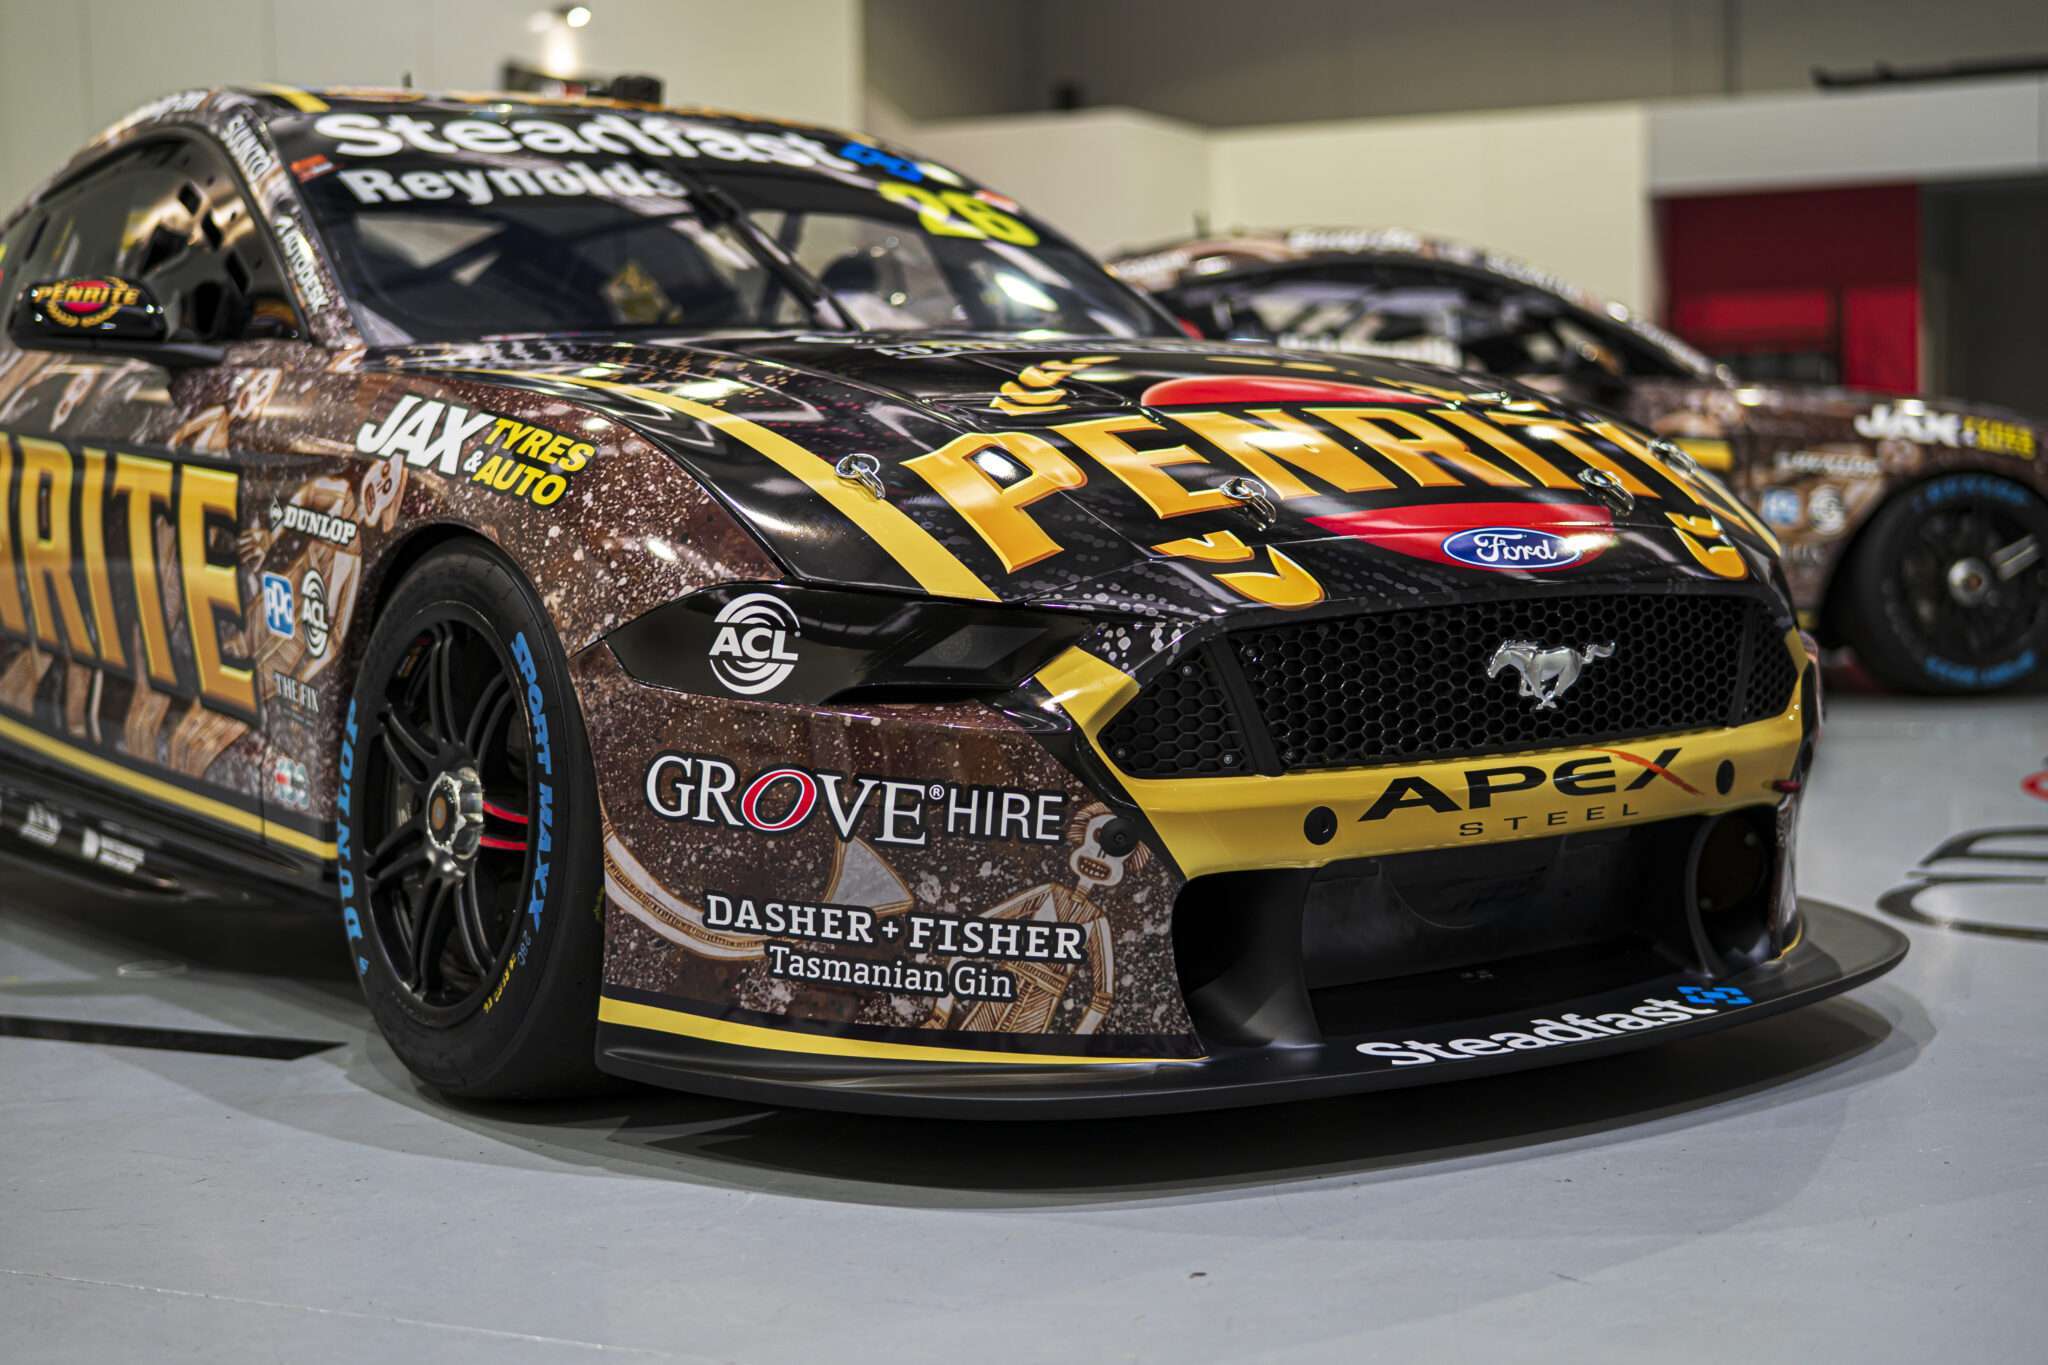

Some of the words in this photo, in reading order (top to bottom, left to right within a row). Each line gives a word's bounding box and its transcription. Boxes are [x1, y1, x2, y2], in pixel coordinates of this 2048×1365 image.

[314, 112, 862, 174] Steadfast
[337, 162, 690, 204] Reynolds
[877, 180, 1040, 247] 26
[33, 283, 140, 305] PENRITE
[356, 394, 498, 475] JAX
[463, 450, 484, 473] &
[484, 417, 596, 473] TYRES
[472, 455, 568, 507] AUTO
[902, 406, 1753, 574] PENRITE
[284, 505, 357, 545] DUNLOP
[1473, 532, 1558, 563] Ford
[265, 581, 293, 628] PPG
[302, 600, 329, 632] ACL
[708, 625, 800, 662] ACL
[274, 672, 298, 703] THE
[300, 682, 320, 714] FIX
[510, 631, 553, 775] SPORT
[1357, 747, 1703, 823] APEX
[337, 697, 362, 942] DUNLOP
[946, 788, 1064, 842] HIRE
[1459, 803, 1639, 837] STEEL
[527, 782, 553, 934] MAXX
[706, 893, 874, 944] DASHER
[908, 915, 1088, 961] FISHER
[769, 944, 945, 994] Tasmanian
[953, 971, 1012, 998] Gin
[1356, 998, 1718, 1067] Steadfast
